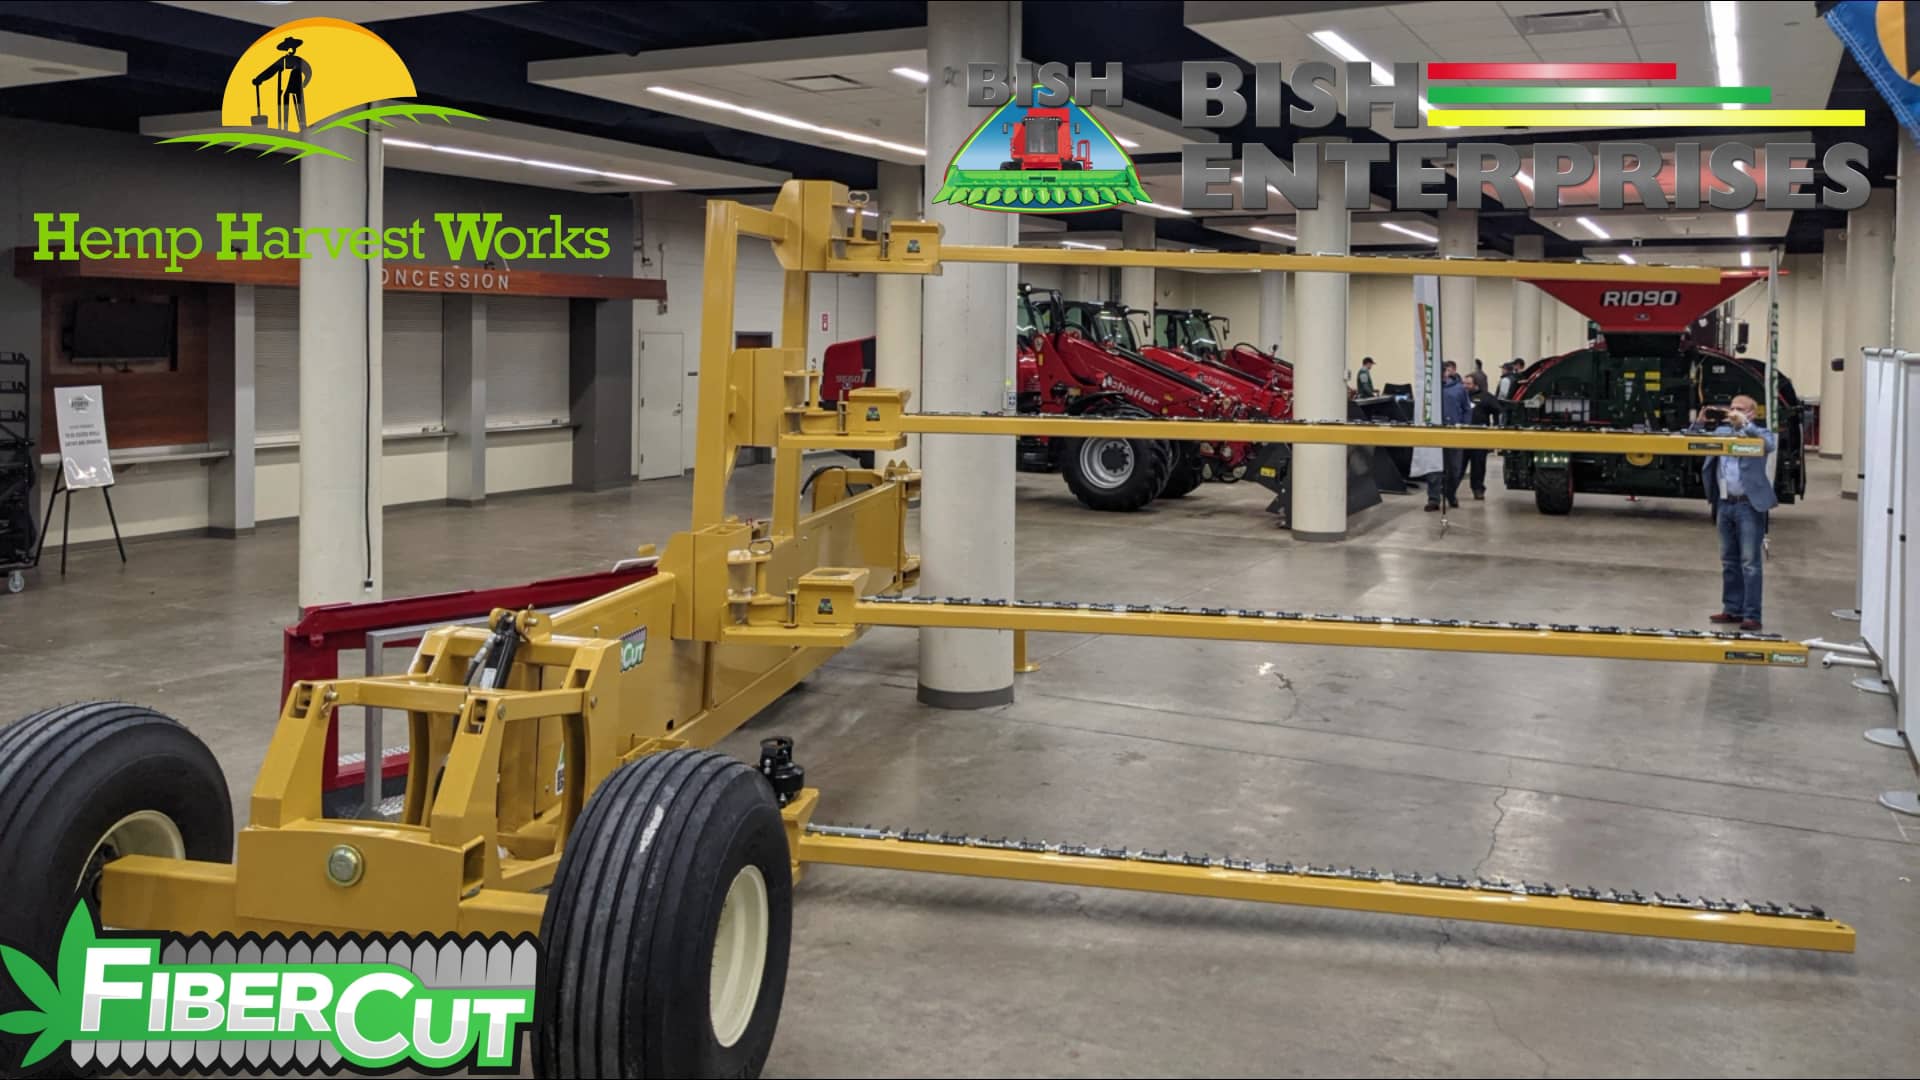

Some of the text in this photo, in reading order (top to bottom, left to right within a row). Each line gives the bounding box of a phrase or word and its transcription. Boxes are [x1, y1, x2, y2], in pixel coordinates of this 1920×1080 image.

[382, 269, 509, 290] ONCESSION
[1603, 290, 1678, 307] R1090
[622, 641, 645, 669] CUT
